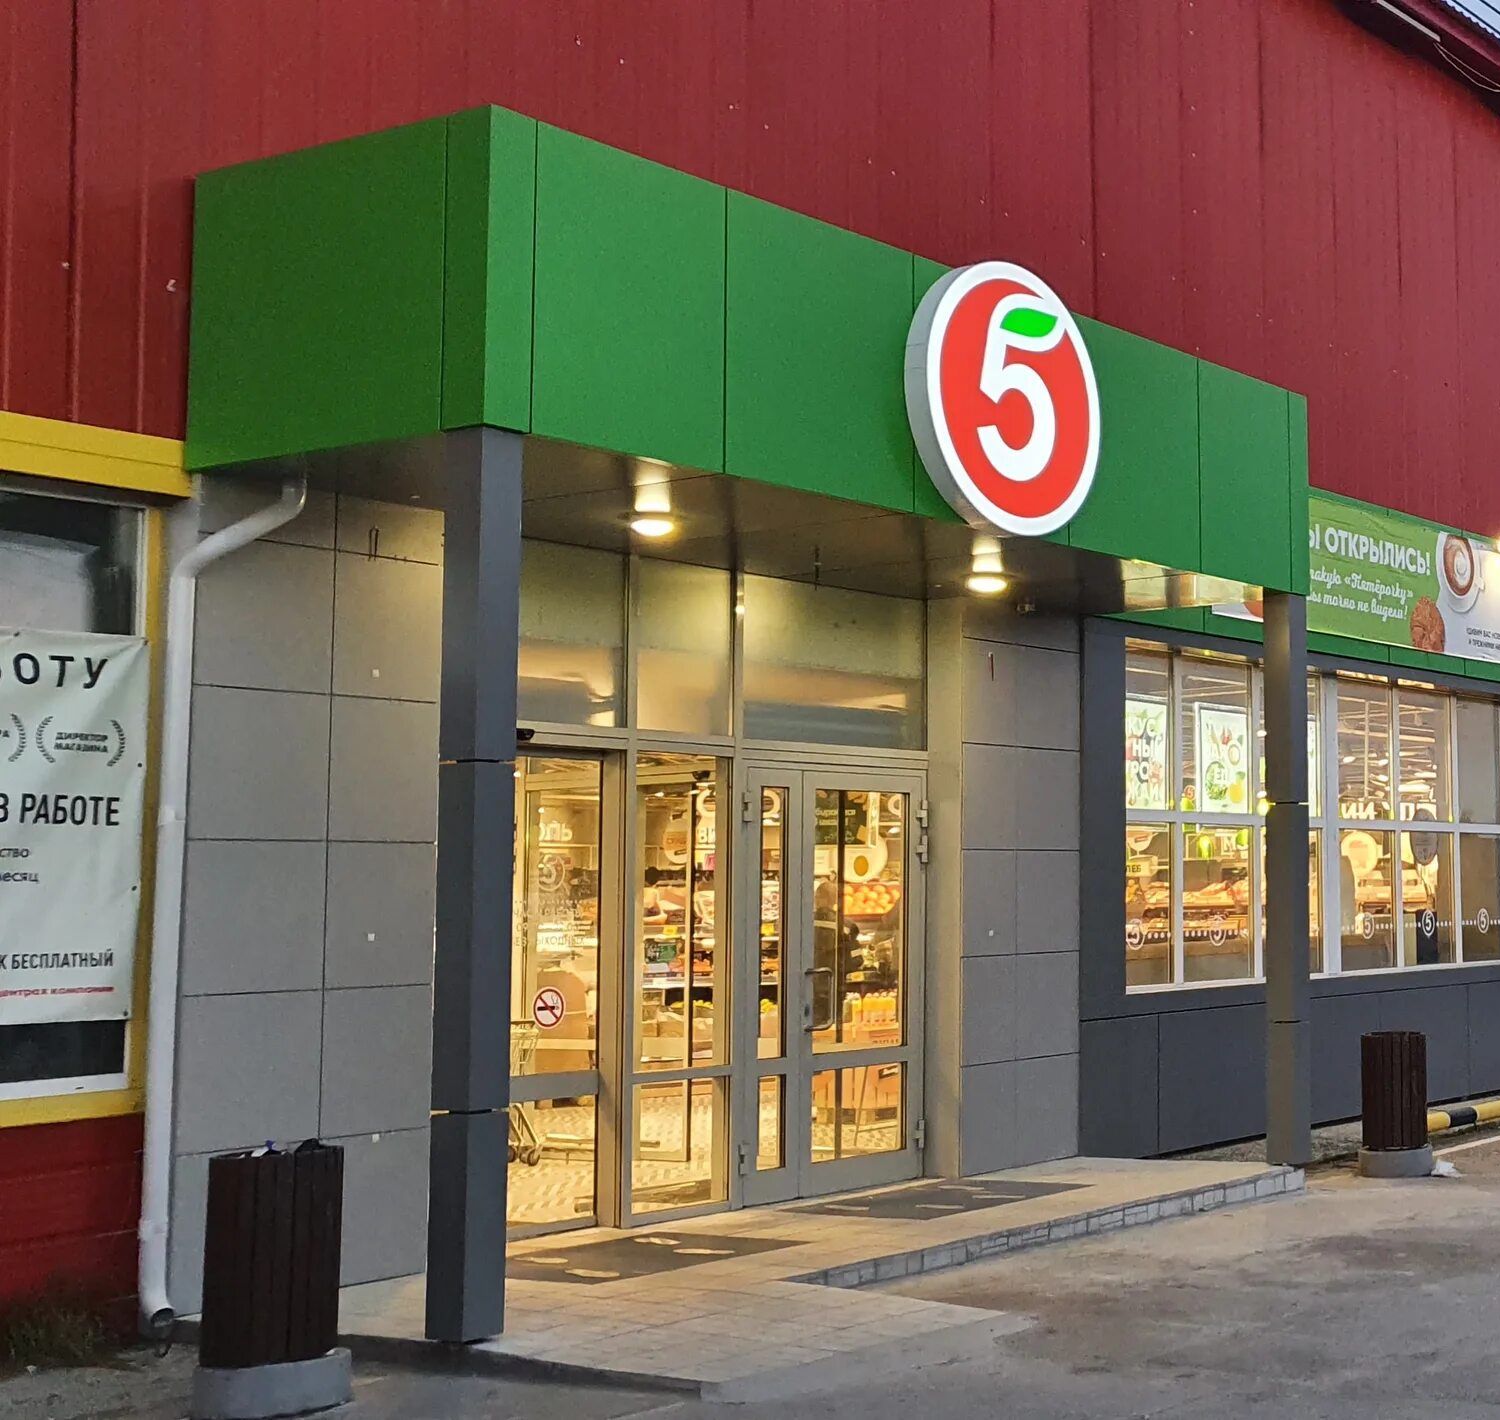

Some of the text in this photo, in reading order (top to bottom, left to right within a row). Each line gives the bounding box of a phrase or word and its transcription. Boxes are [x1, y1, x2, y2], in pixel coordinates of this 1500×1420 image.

[1324, 527, 1431, 576] ОТКРЫЛИСЬ!
[0, 652, 108, 689] ОТУ
[19, 793, 120, 827] РАБОТЕ
[11, 948, 114, 969] БЕСПЛАТНЫЙ
